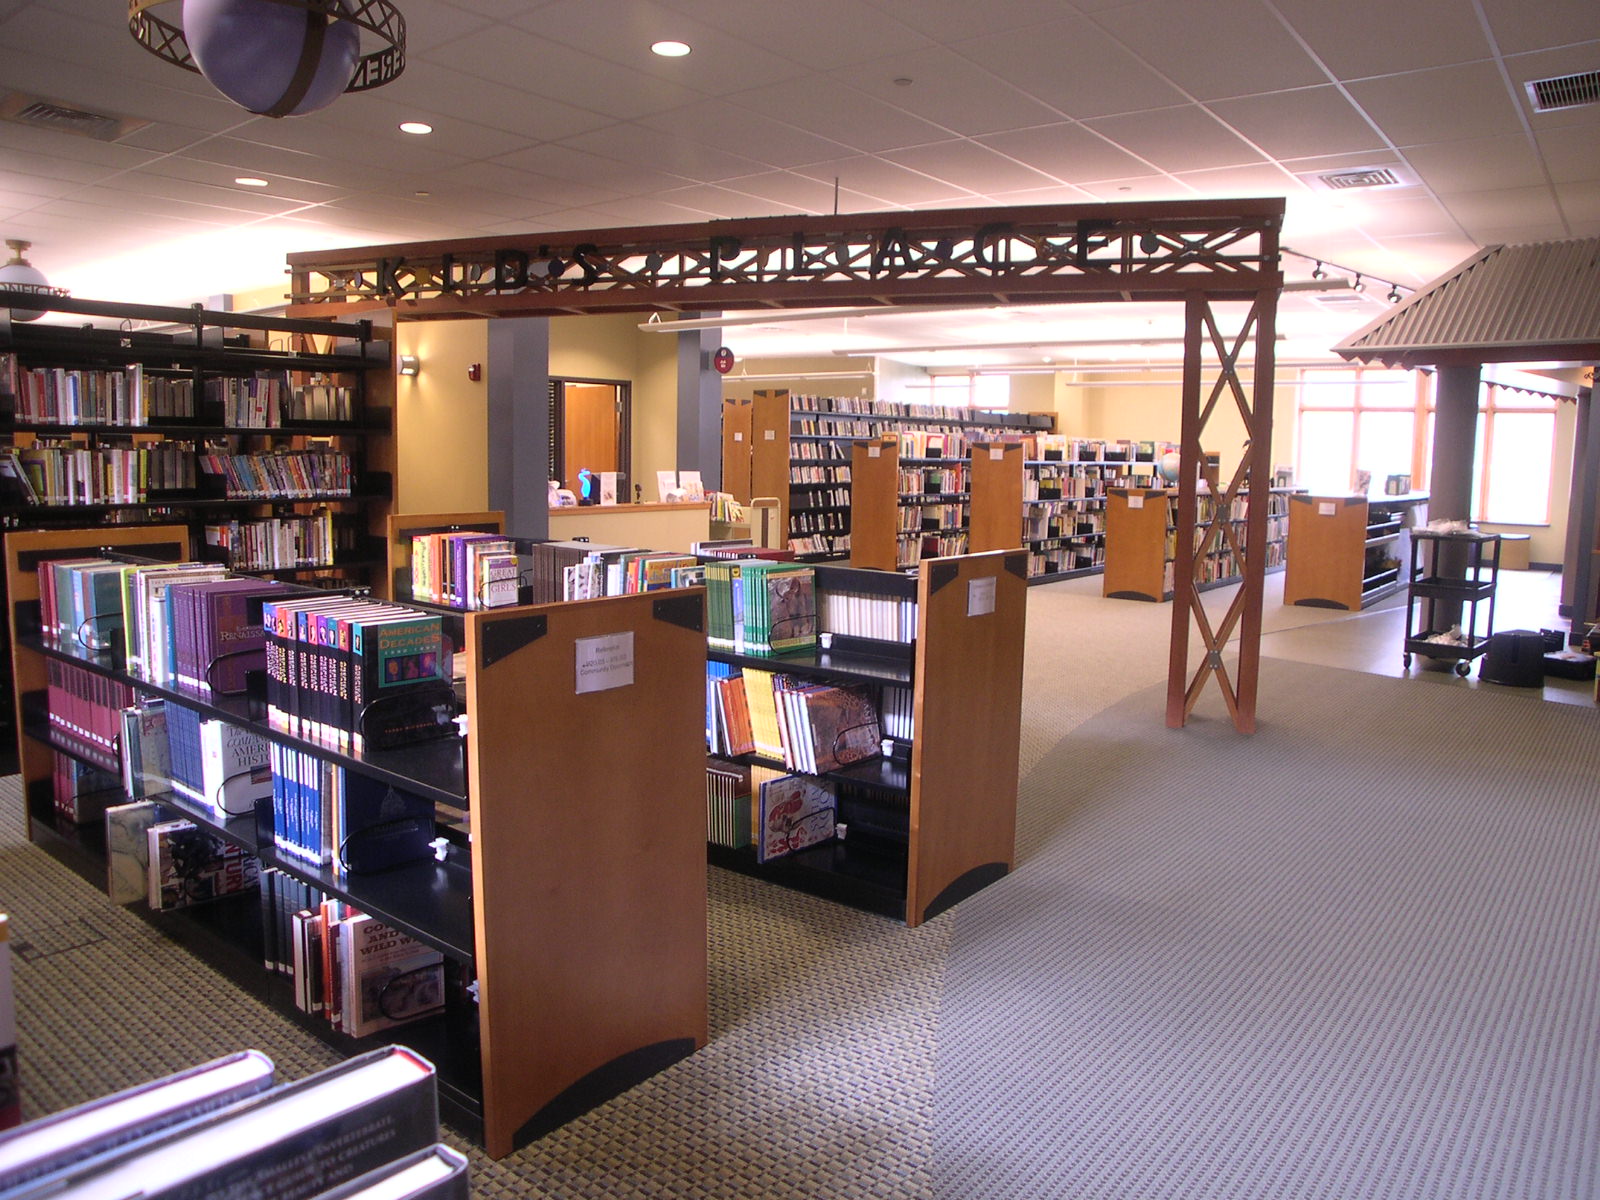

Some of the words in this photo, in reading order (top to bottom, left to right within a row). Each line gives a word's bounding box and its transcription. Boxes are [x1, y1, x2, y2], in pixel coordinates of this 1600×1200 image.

[376, 243, 598, 297] KID'S
[710, 219, 1111, 280] PLACE
[491, 583, 516, 592] GIRLS
[380, 623, 440, 638] AMERICAN
[380, 634, 440, 649] DECADES
